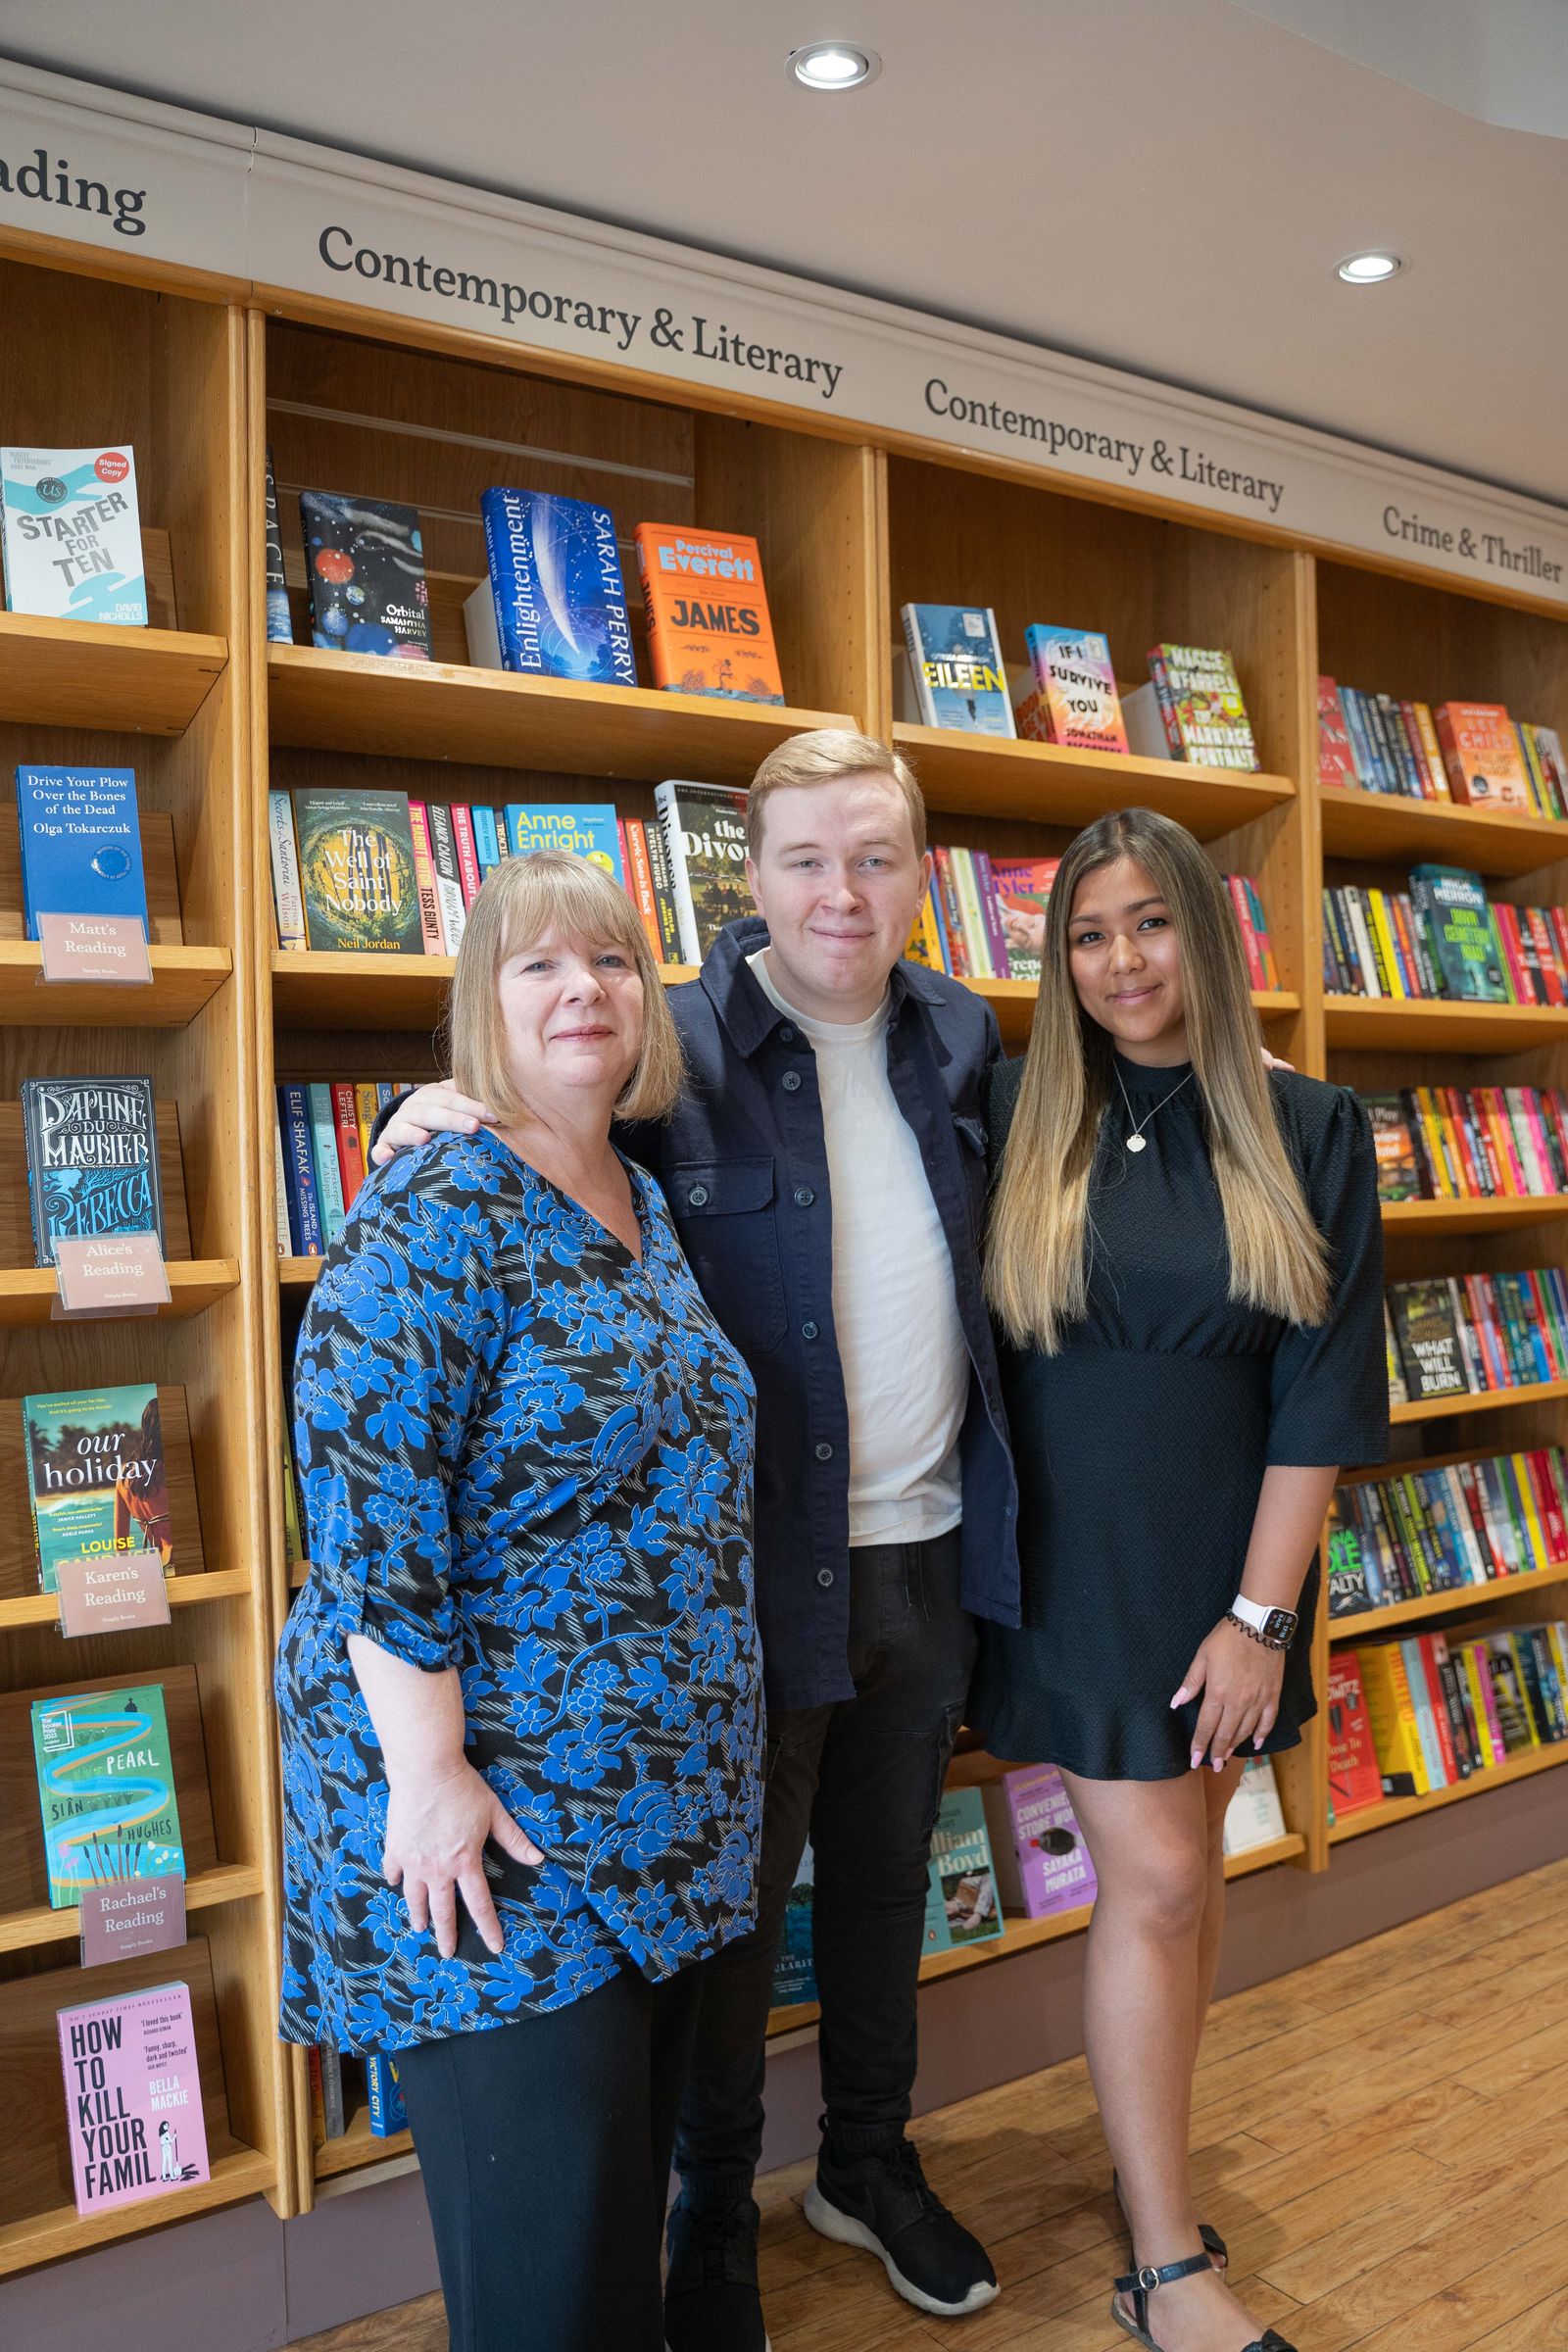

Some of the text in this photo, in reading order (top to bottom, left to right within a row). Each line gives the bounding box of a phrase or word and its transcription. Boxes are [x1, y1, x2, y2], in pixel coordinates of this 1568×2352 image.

[318, 225, 844, 399] Contemporary & Literary
[924, 378, 1285, 513] Contemporary & Literary
[99, 458, 127, 468] Signed
[101, 467, 122, 478] Copy
[17, 492, 128, 540] STARTER
[65, 534, 100, 557] FOR
[675, 539, 733, 560] Percival
[1383, 505, 1563, 584] Crime & Thriller
[52, 548, 115, 587] TEN
[658, 546, 754, 581] Everett
[502, 492, 542, 668] Enlightenment
[116, 603, 142, 612] DAVID
[489, 552, 499, 583] PERRY
[494, 590, 508, 657] Enlightenment
[592, 511, 635, 685] SARAH PERRY
[99, 612, 143, 621] NICHOLLS
[380, 615, 426, 630] SAMANTHA
[386, 604, 424, 619] Orbital
[670, 600, 760, 636] JAMES
[394, 625, 427, 638] HARVEY
[922, 662, 1005, 692] EILEEN
[1050, 665, 1112, 696] SURVIVE
[1067, 700, 1099, 713] YOU
[1466, 717, 1499, 732] LEE
[1459, 731, 1513, 750] CHILD
[27, 775, 128, 788] Drive Your Plow
[33, 789, 126, 802] Over the Bones
[45, 805, 116, 815] of the Dead
[409, 807, 423, 824] THE
[455, 807, 467, 824] THE
[516, 810, 576, 831] Anne
[33, 822, 131, 836] Olga Tokarczuk
[432, 805, 447, 844] ELEANOR
[713, 819, 746, 840] the
[337, 829, 377, 848] The
[411, 824, 427, 856] RABBIT
[459, 825, 471, 858] TRUTH
[496, 822, 507, 857] TREACLE
[517, 830, 595, 853] Enright
[278, 835, 295, 887] Santorini
[324, 851, 393, 869] Well of
[629, 824, 642, 858] Carrie
[641, 888, 653, 915] Back
[648, 827, 663, 890] EVELYN HUGO
[333, 871, 386, 891] Saint
[464, 858, 479, 891] ABOUT
[991, 863, 1033, 879] Anne
[992, 879, 1036, 898] Tyler
[280, 892, 292, 929] Wilson
[325, 894, 402, 916] Nobody
[420, 887, 440, 941] TESS GUNTY
[69, 921, 117, 936] Matt's
[65, 941, 126, 956] Reading
[337, 938, 401, 950] Neil Jordan
[37, 1086, 147, 1131] DAPHNE
[338, 1091, 349, 1129] LEFTERI
[345, 1090, 357, 1130] CHRISTY
[83, 1120, 105, 1134] DU
[289, 1091, 310, 1174] ELIF SHAFAK
[40, 1129, 150, 1167] MAURIER
[331, 1166, 340, 1206] Beekeeper
[44, 1169, 154, 1239] REBECCA
[299, 1187, 310, 1218] MISSING
[309, 1201, 318, 1230] ISLAND
[86, 1244, 132, 1255] Alice's
[84, 1263, 144, 1277] Reading
[1411, 1337, 1454, 1358] WHAT
[1419, 1355, 1456, 1373] WILL
[1420, 1371, 1462, 1392] BURN
[76, 1431, 125, 1455] our
[43, 1454, 158, 1489] holiday
[80, 1536, 136, 1553] LOUISE
[84, 1566, 139, 1585] Karen's
[1327, 1572, 1365, 1596] ALTY
[84, 1588, 147, 1607] Reading
[107, 1748, 159, 1774] PEARL
[52, 1796, 84, 1821] SIÂN
[127, 1819, 172, 1841] HUGHES
[931, 1828, 986, 1854] lliam
[937, 1848, 989, 1877] Boyd
[100, 1885, 167, 1912] Rachael's
[104, 1910, 165, 1934] Reading
[71, 2015, 122, 2058] HOW
[146, 2050, 168, 2063] dark and
[74, 2056, 106, 2093] TO
[149, 2076, 180, 2096] BELLA
[369, 2057, 381, 2118] VICTORY CITY
[77, 2086, 130, 2128] KILL
[150, 2089, 189, 2113] MACKIE
[81, 2118, 147, 2163] YOUR
